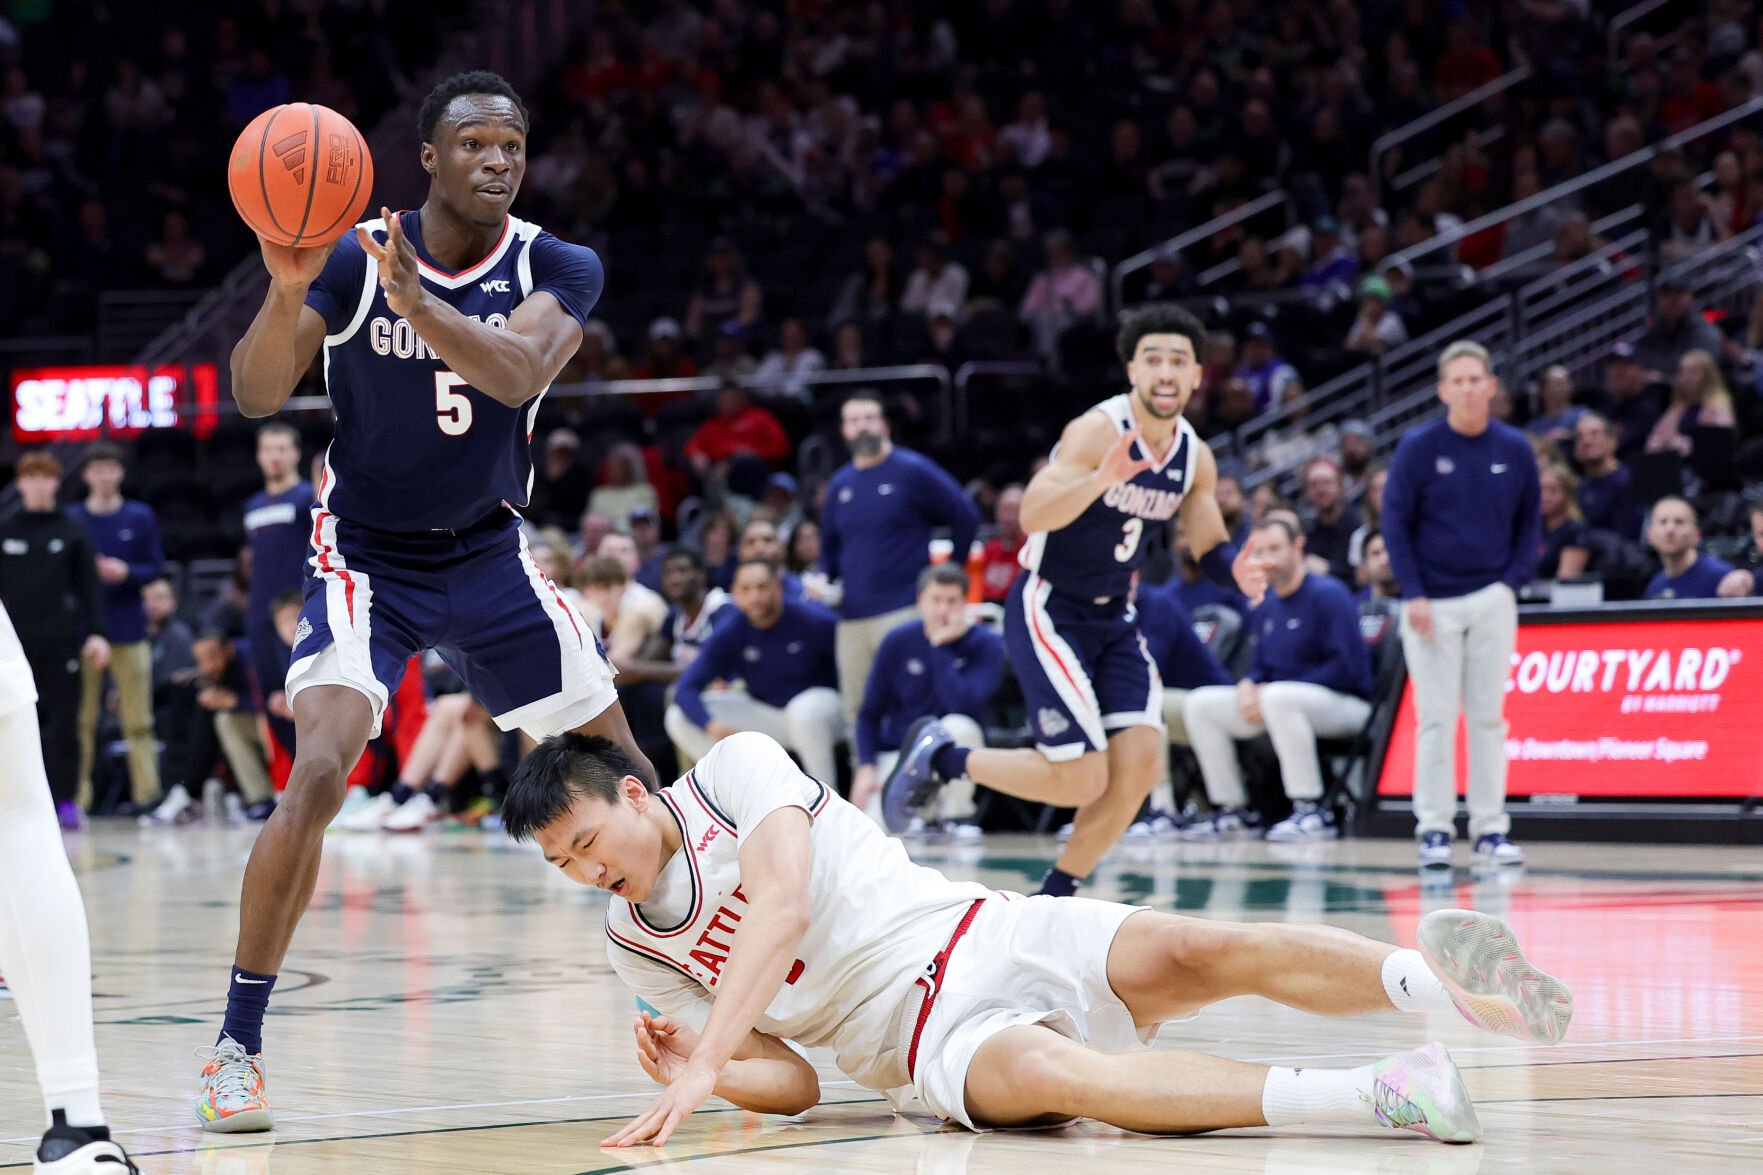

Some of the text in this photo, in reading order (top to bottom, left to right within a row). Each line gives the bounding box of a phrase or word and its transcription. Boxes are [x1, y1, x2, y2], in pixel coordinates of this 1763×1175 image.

[326, 134, 342, 184] PRO
[480, 280, 511, 297] WCC
[15, 375, 178, 431] SEATTLE
[434, 370, 473, 436] 5
[1114, 518, 1143, 562] 3
